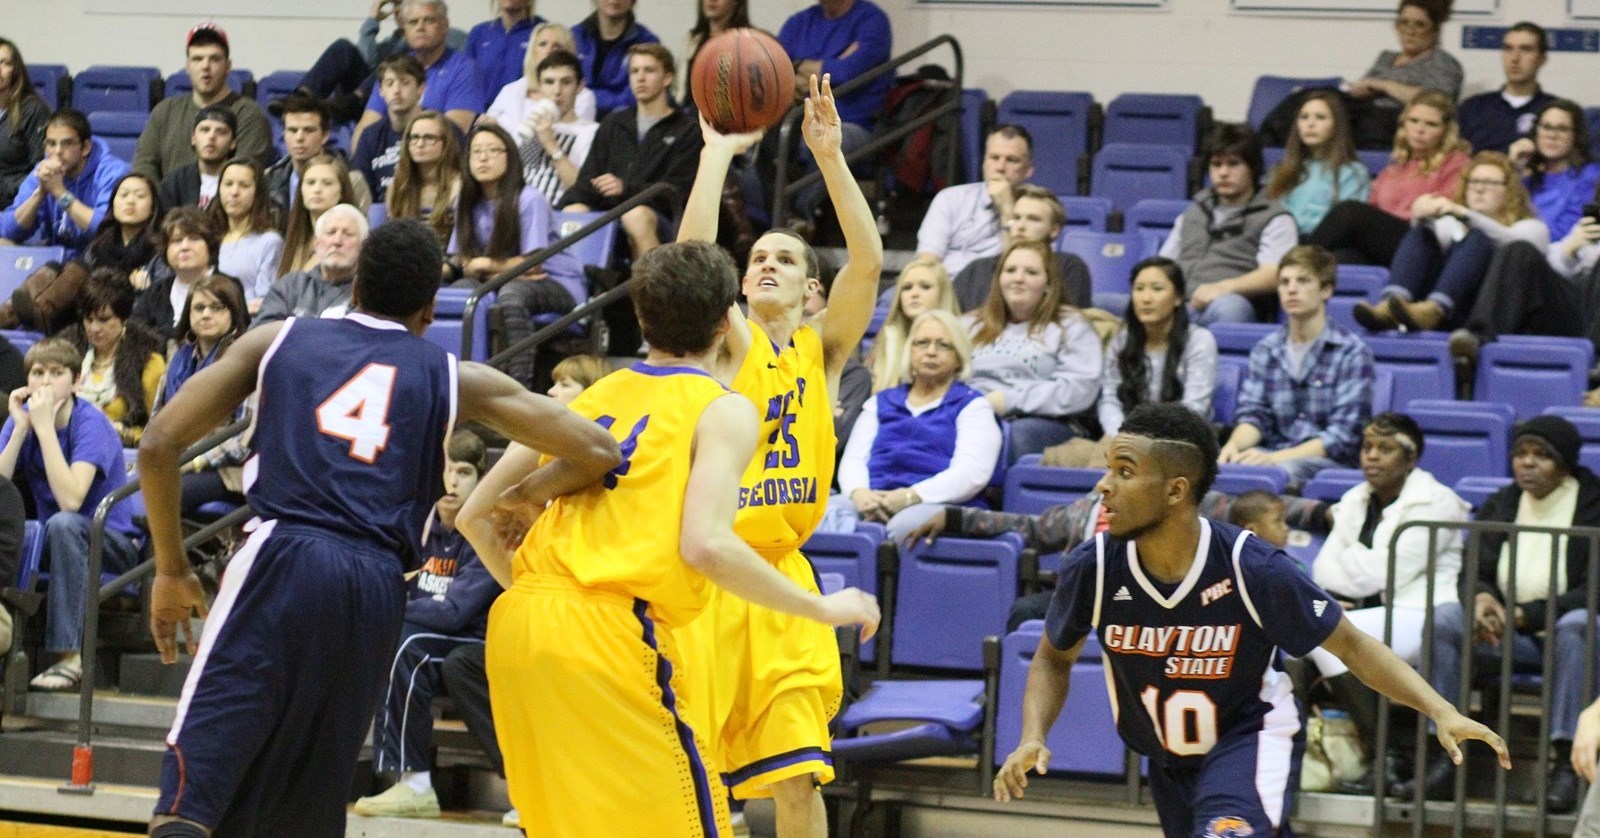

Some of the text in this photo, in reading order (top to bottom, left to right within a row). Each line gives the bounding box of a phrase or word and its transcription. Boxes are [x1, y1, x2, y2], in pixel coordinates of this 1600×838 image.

[314, 362, 397, 465] 4
[1200, 577, 1233, 607] PBC
[1104, 623, 1242, 657] CLAYTON
[1164, 656, 1236, 680] STATE
[1139, 684, 1218, 757] 10
